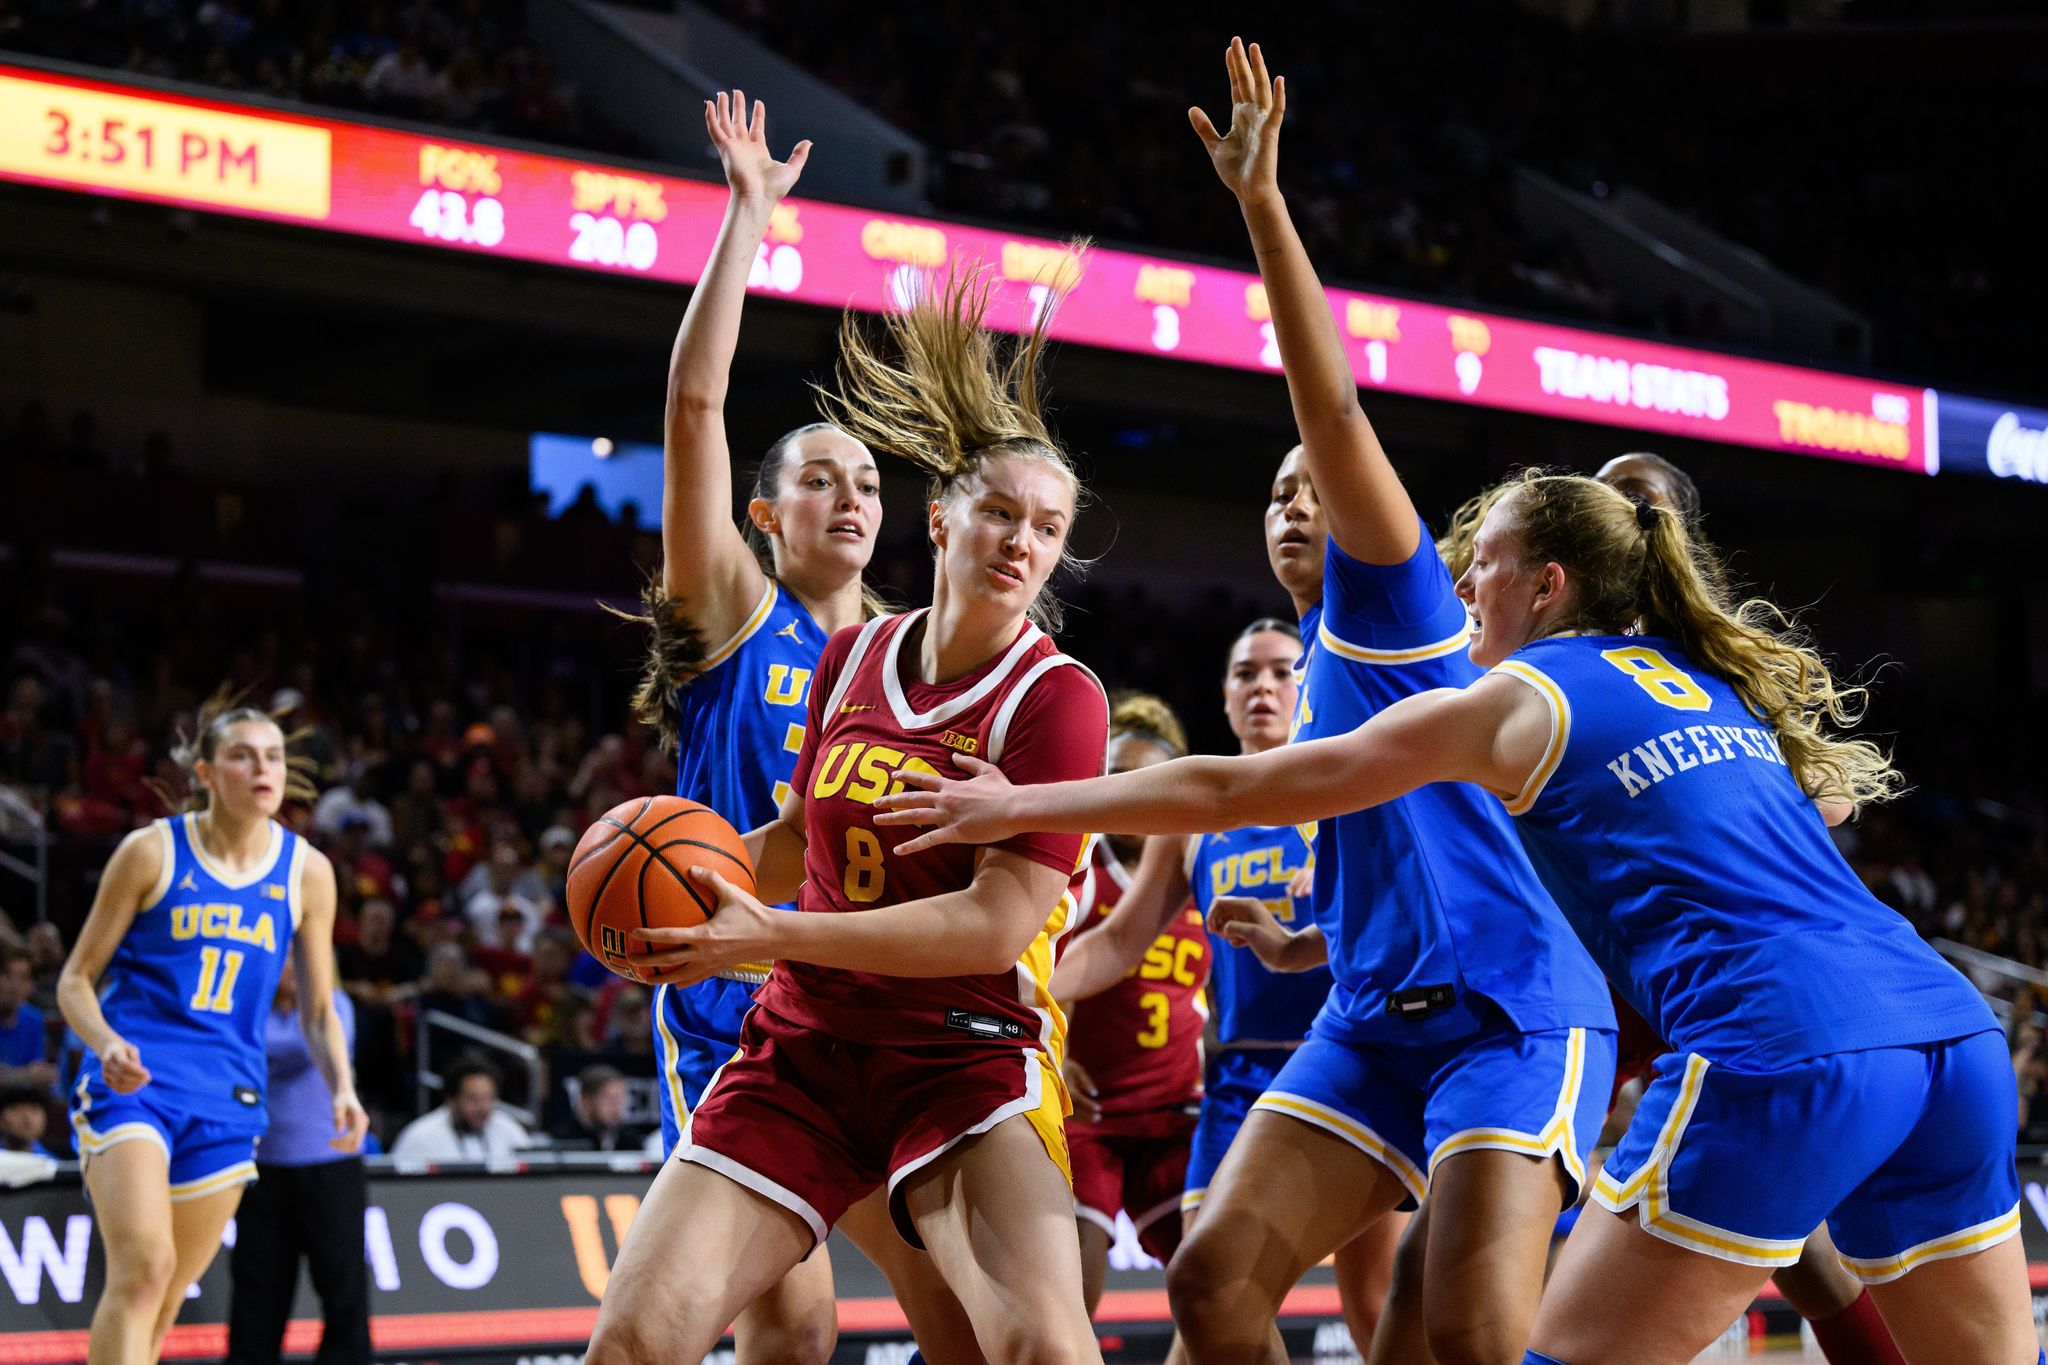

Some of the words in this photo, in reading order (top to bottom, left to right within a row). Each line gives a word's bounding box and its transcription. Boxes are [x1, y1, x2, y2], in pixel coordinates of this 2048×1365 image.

[46, 109, 153, 170] 3:51
[180, 131, 259, 186] PM
[568, 212, 658, 270] 20.0
[1151, 304, 1180, 351] 3
[1364, 339, 1388, 385] 1
[1454, 350, 1483, 396] 9
[1533, 345, 1631, 406] TEAM
[1630, 362, 1730, 421] STATS
[1600, 645, 1714, 713] 8
[843, 825, 886, 903] 8
[1211, 847, 1316, 898] UCL
[170, 902, 276, 955] UCLA
[190, 945, 245, 1015] 11
[1126, 934, 1204, 988] SC
[1005, 1023, 1019, 1034] 48
[1136, 992, 1170, 1048] 3
